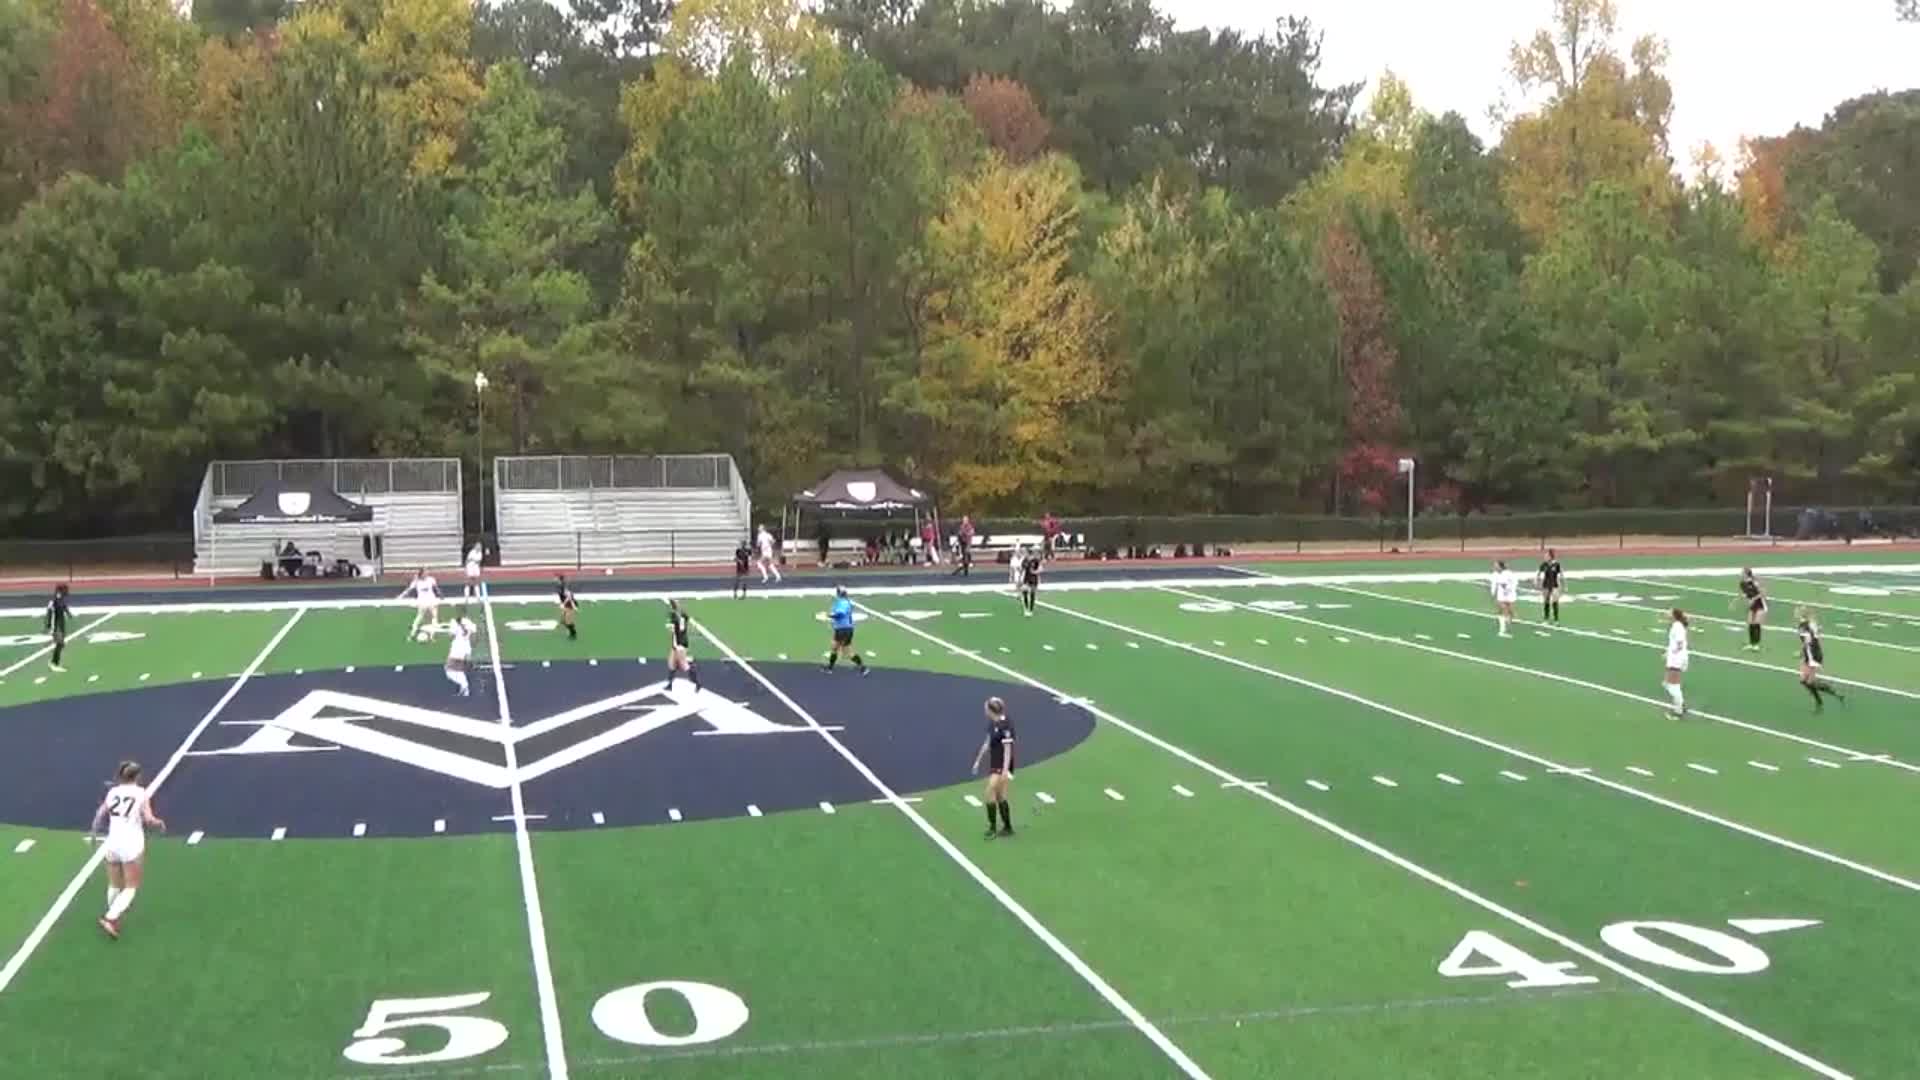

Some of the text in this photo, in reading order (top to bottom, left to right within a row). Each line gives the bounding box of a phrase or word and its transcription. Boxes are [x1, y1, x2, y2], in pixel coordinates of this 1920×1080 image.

[109, 795, 137, 819] 27
[1437, 920, 1770, 988] 40
[342, 980, 749, 1064] 50
